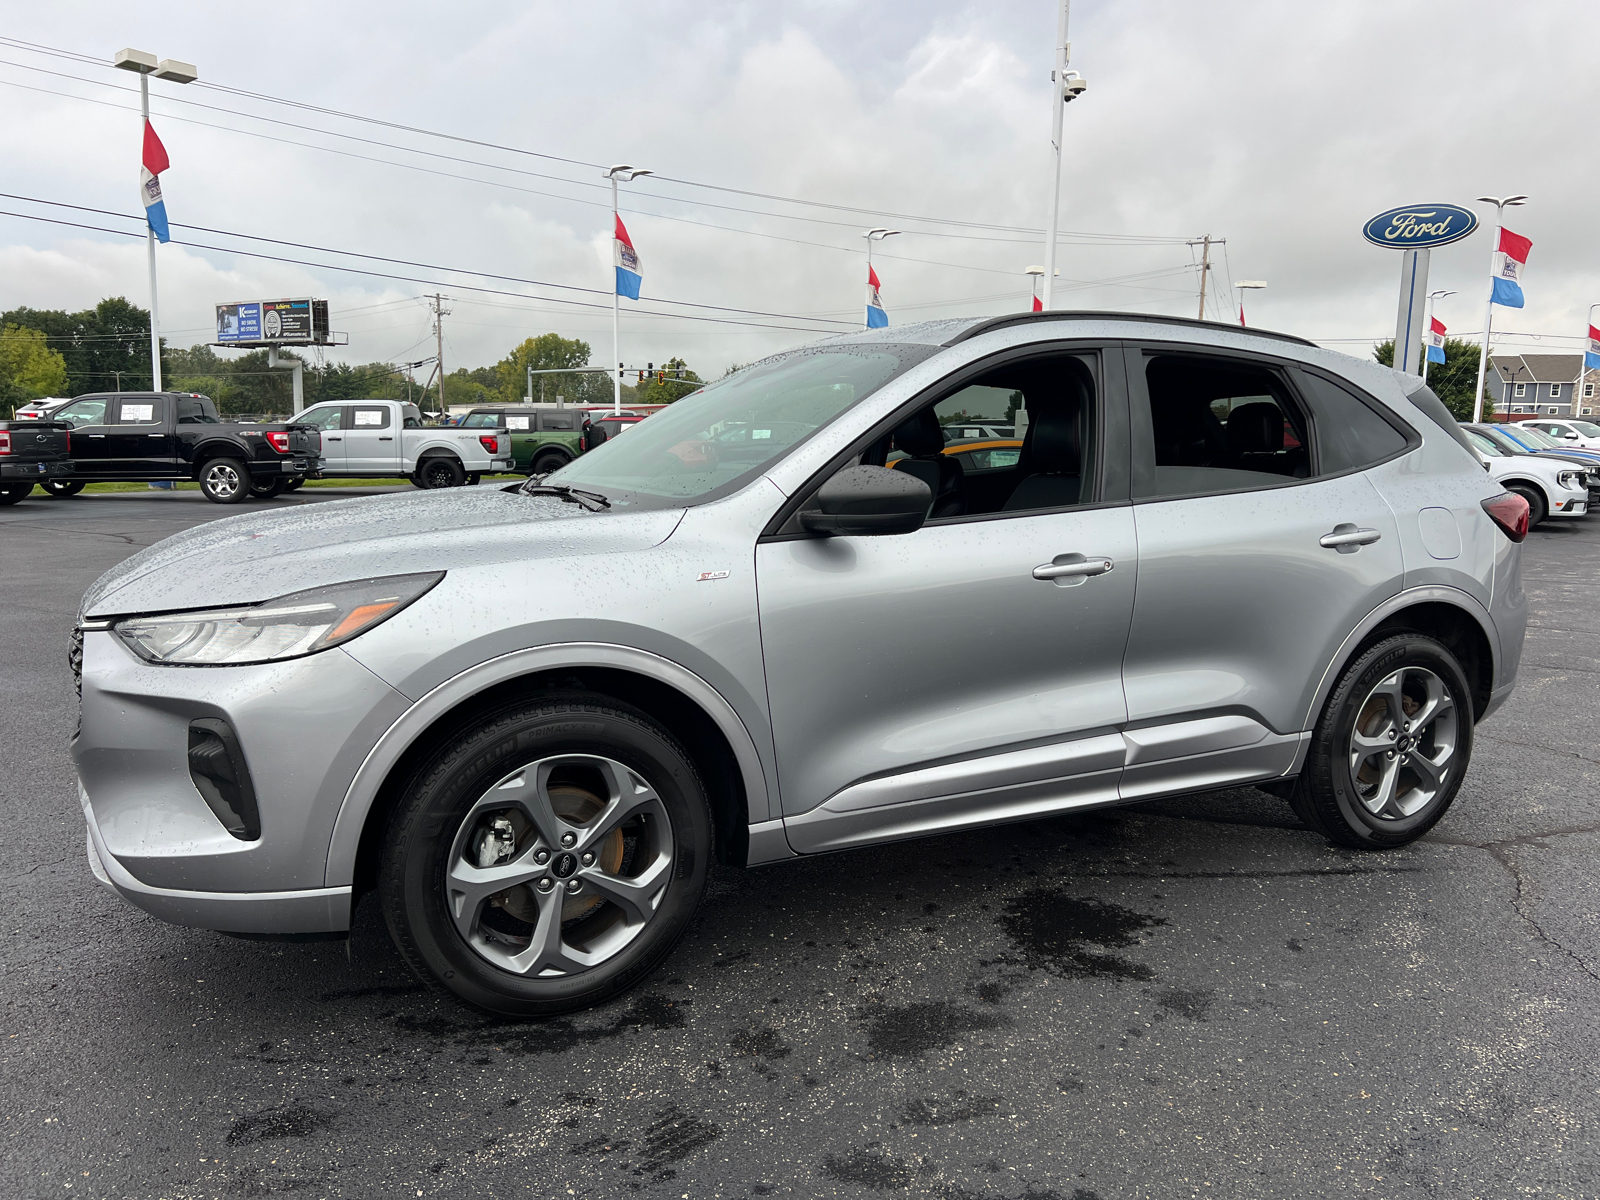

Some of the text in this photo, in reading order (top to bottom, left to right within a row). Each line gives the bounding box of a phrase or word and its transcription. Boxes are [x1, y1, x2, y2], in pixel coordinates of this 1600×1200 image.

[1384, 211, 1454, 240] Ford
[528, 723, 578, 739] PRIMACY
[440, 740, 514, 807] MICHELIN
